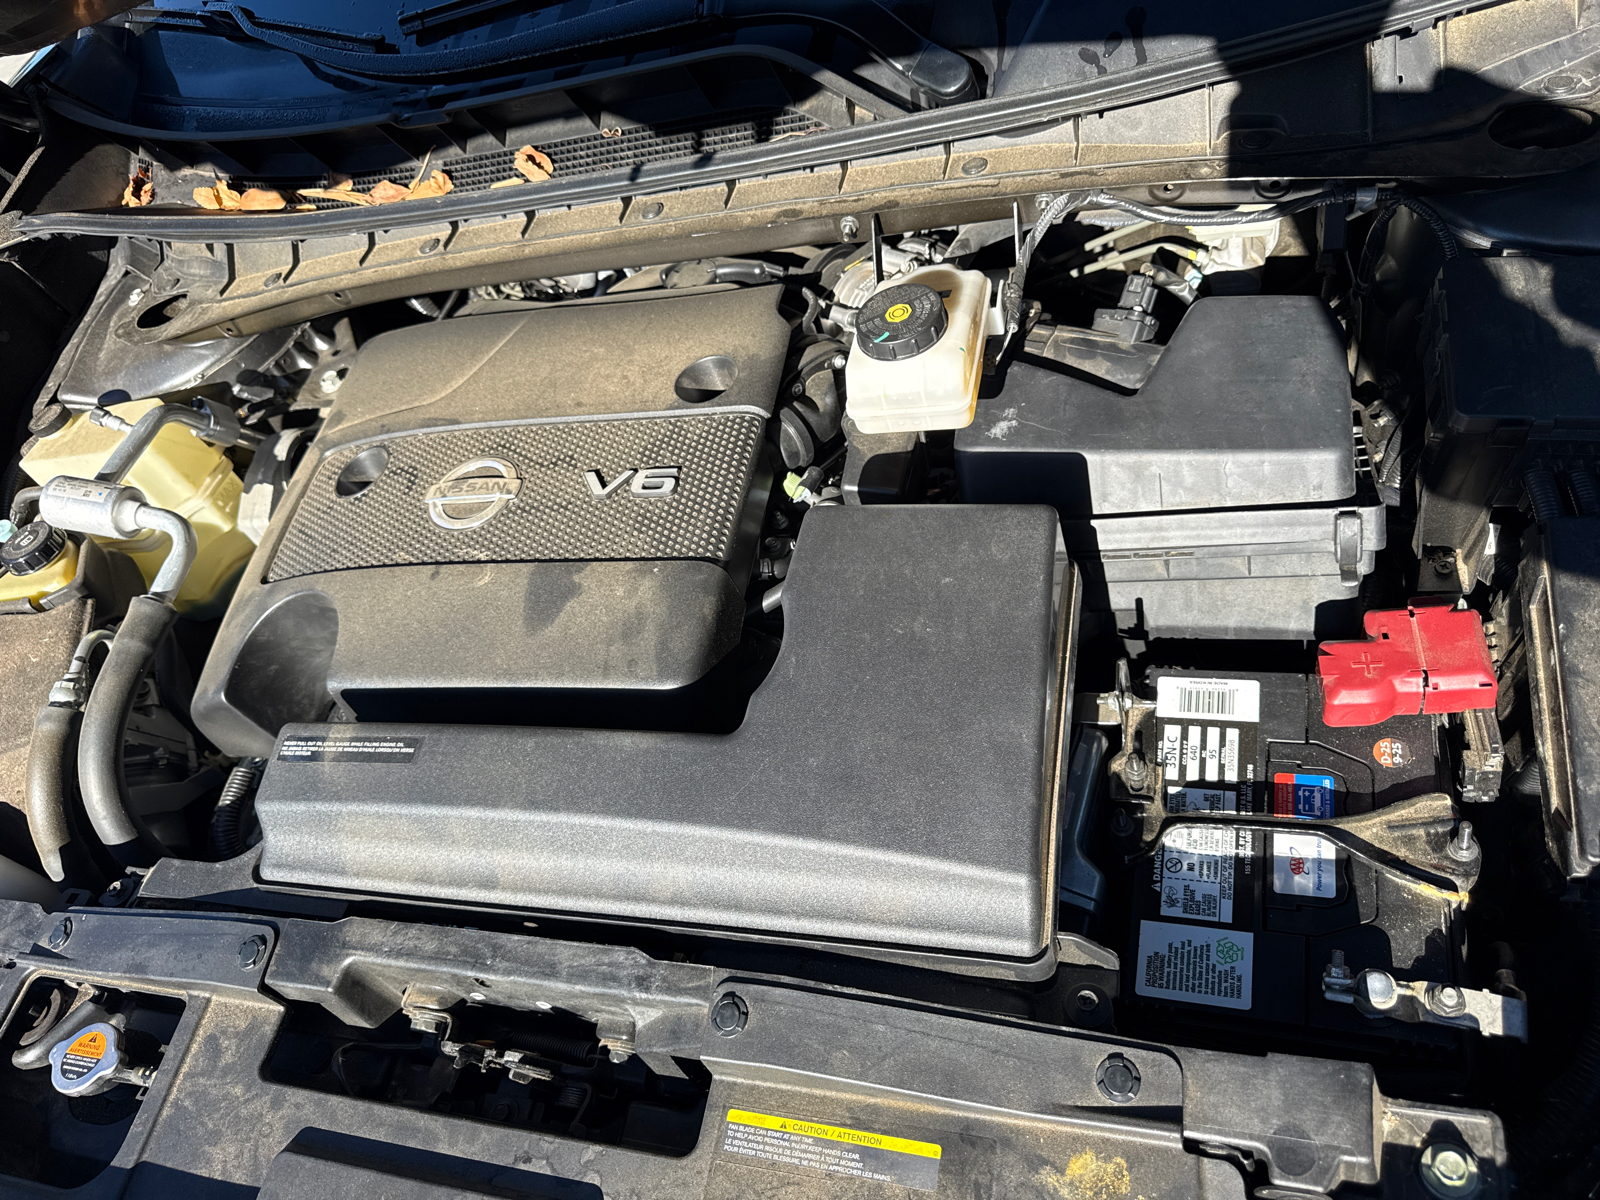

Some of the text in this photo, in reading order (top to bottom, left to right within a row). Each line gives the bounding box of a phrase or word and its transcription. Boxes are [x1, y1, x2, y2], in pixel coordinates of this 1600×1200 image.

[435, 480, 507, 497] NISSAN
[584, 467, 680, 500] V6
[1164, 735, 1178, 769] 35N-C
[1190, 745, 1198, 761] 640
[1209, 749, 1217, 760] 95
[1380, 742, 1391, 763] D-25
[1391, 742, 1403, 763] 9-25
[1153, 848, 1162, 881] DANGE
[1186, 862, 1195, 872] NO
[1145, 955, 1153, 987] CALIFORNIA
[1151, 951, 1160, 988] PROPOSITION
[728, 1123, 738, 1131] FAN
[739, 1125, 755, 1134] BLADE
[755, 1128, 767, 1136] CAN
[767, 1130, 783, 1139] START
[783, 1132, 790, 1140] AT
[792, 1123, 828, 1136] CAUTION
[837, 1131, 882, 1146] ATTENTION
[732, 1139, 764, 1150] VENTILATEUR
[764, 1144, 783, 1153] RISQUE
[792, 1149, 820, 1161] DÉMARRER
[826, 1157, 839, 1165] TOUT
[735, 1131, 748, 1139] HELP
[748, 1134, 763, 1142] AVOID
[764, 1137, 790, 1147] PERSONAL
[822, 1149, 841, 1157] HANDS
[724, 1144, 738, 1153] POUR
[739, 1146, 756, 1156] ÉVITER
[756, 1150, 773, 1159] TOUTE
[809, 1160, 820, 1169] PAS
[828, 1164, 861, 1176] APPROCHER
[862, 1170, 873, 1178] LES
